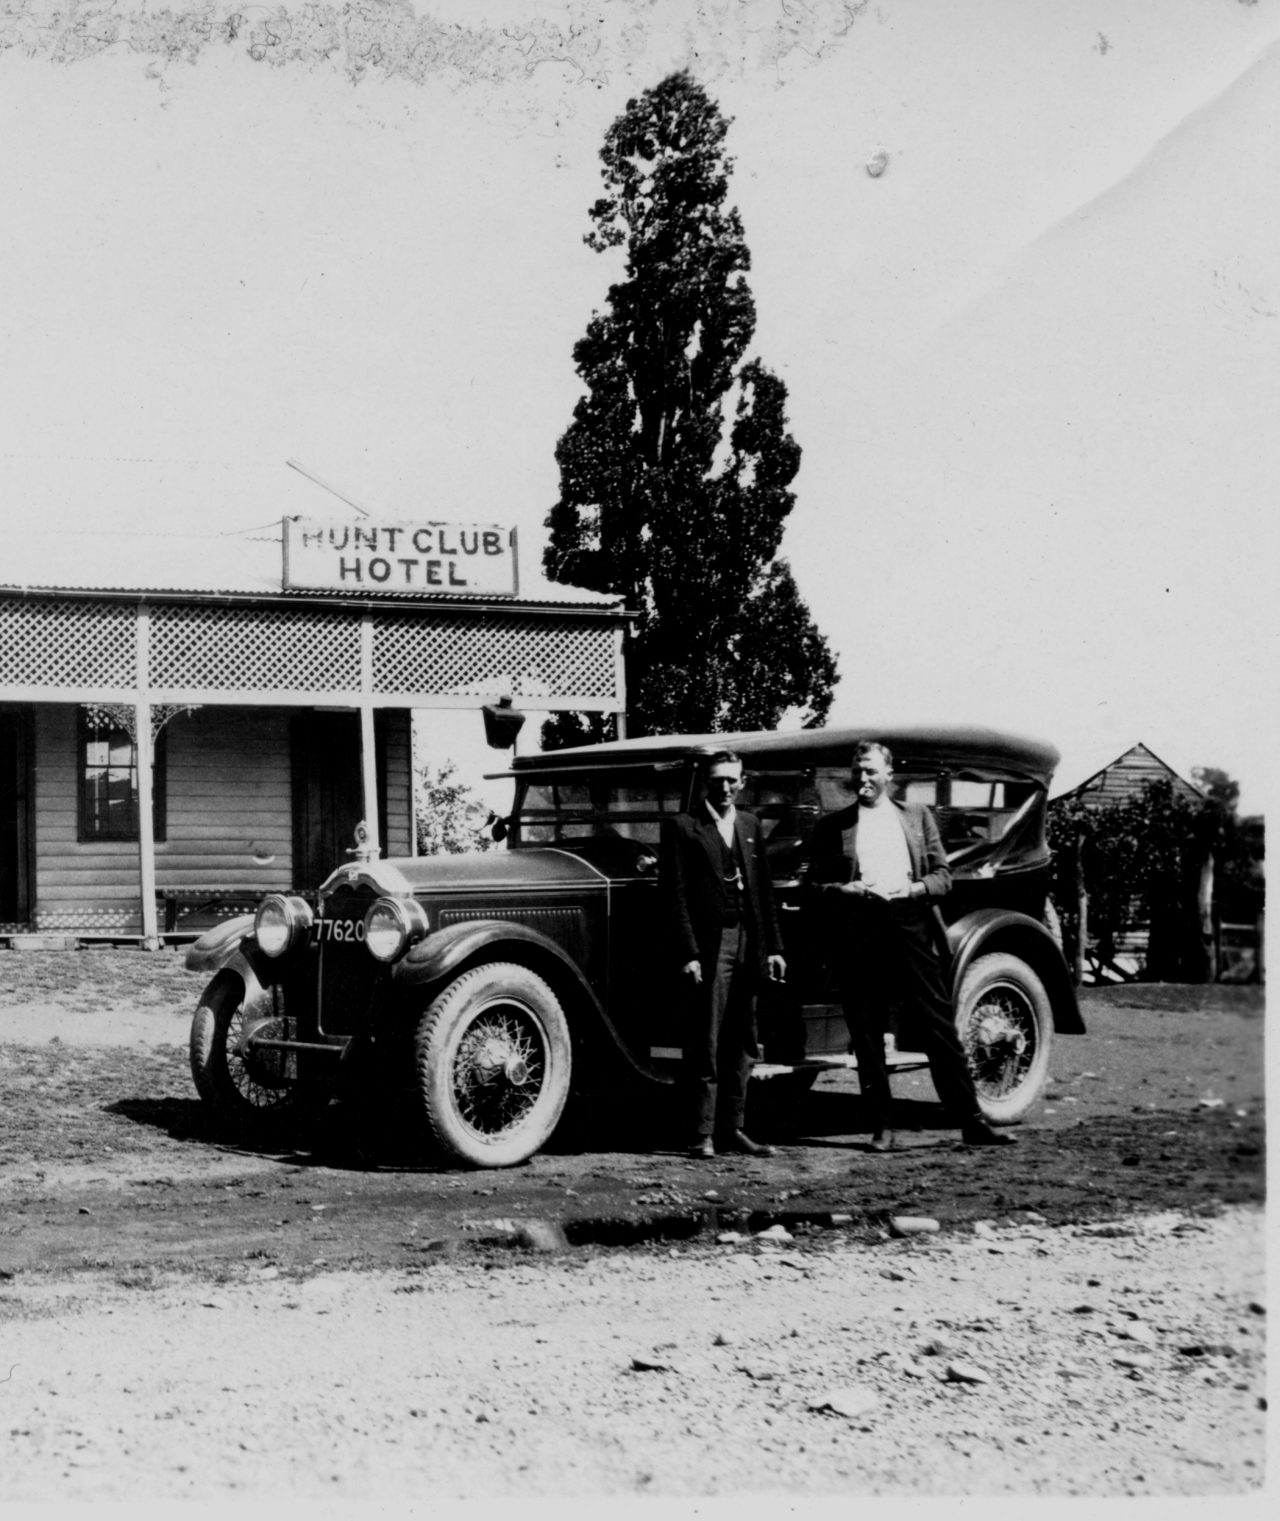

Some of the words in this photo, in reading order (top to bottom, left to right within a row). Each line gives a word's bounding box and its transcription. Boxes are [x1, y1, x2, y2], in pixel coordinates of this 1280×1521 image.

[302, 526, 404, 552] HUNT
[412, 529, 504, 555] CLUB
[340, 557, 467, 586] HOTEL
[314, 919, 365, 941] 77620
